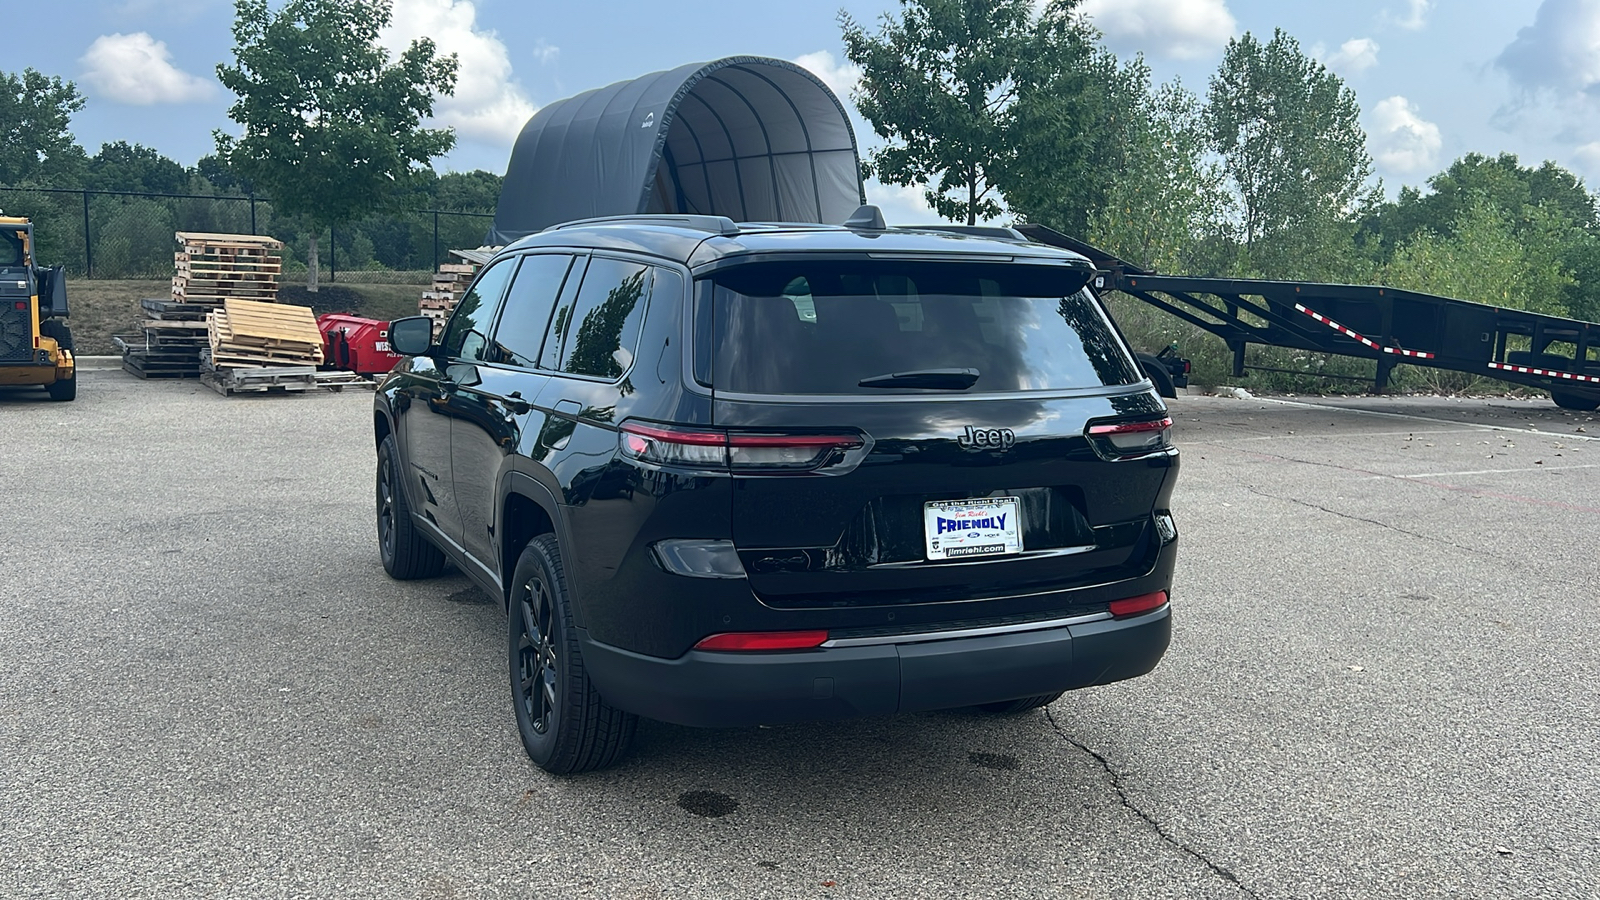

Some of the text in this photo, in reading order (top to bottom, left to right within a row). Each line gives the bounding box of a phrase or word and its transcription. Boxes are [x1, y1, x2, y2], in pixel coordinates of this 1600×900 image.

[957, 425, 1016, 453] Jeep
[955, 511, 966, 519] Jim
[937, 513, 1006, 534] FRIENDLY
[948, 545, 1004, 556] jimriehl.com
